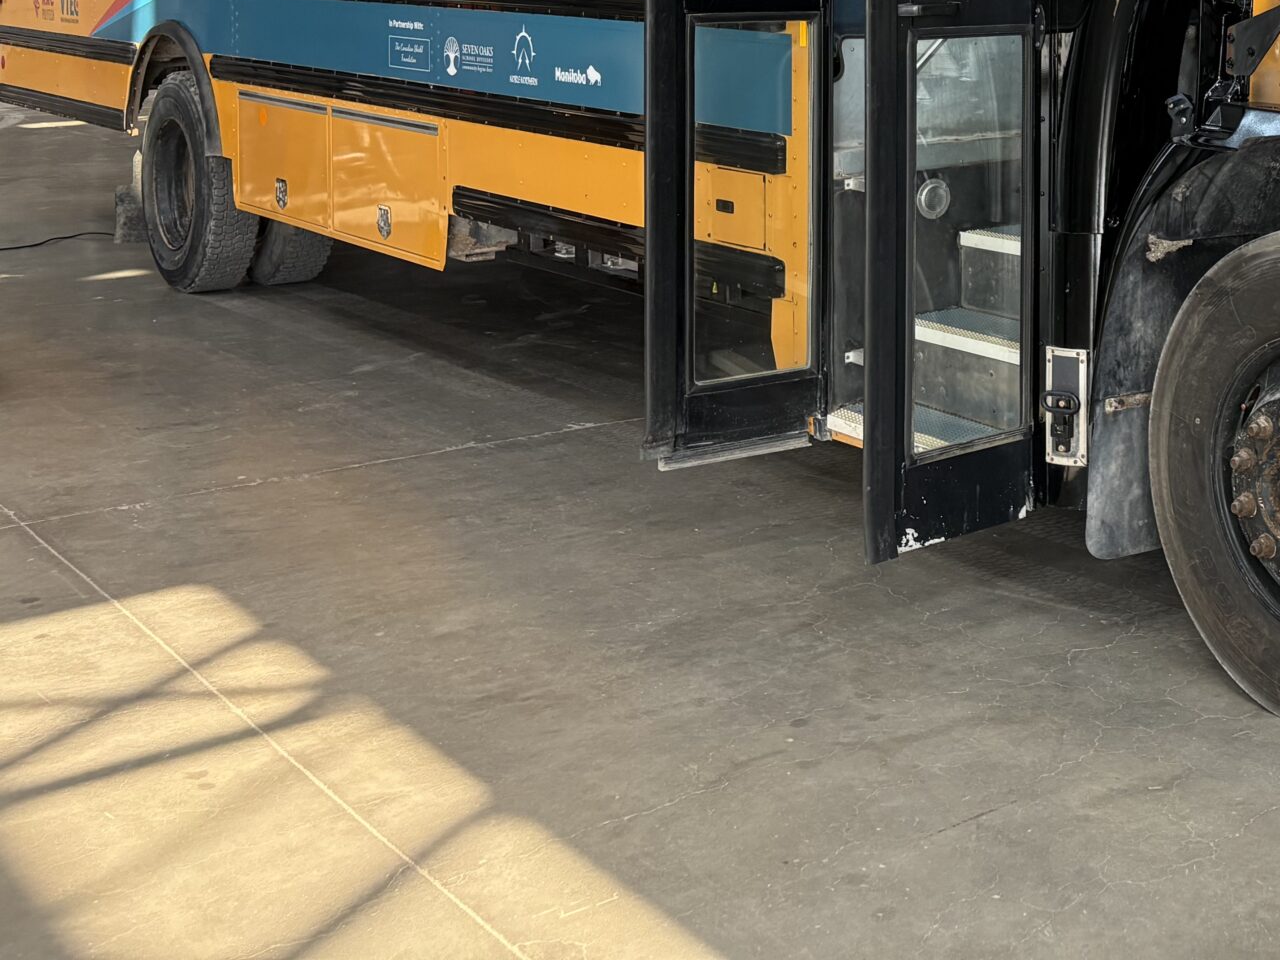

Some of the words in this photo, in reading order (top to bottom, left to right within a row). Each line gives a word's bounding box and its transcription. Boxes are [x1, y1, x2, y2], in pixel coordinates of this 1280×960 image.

[462, 43, 479, 55] SEVEN
[479, 45, 494, 57] OAKS
[555, 67, 587, 84] Manitoba
